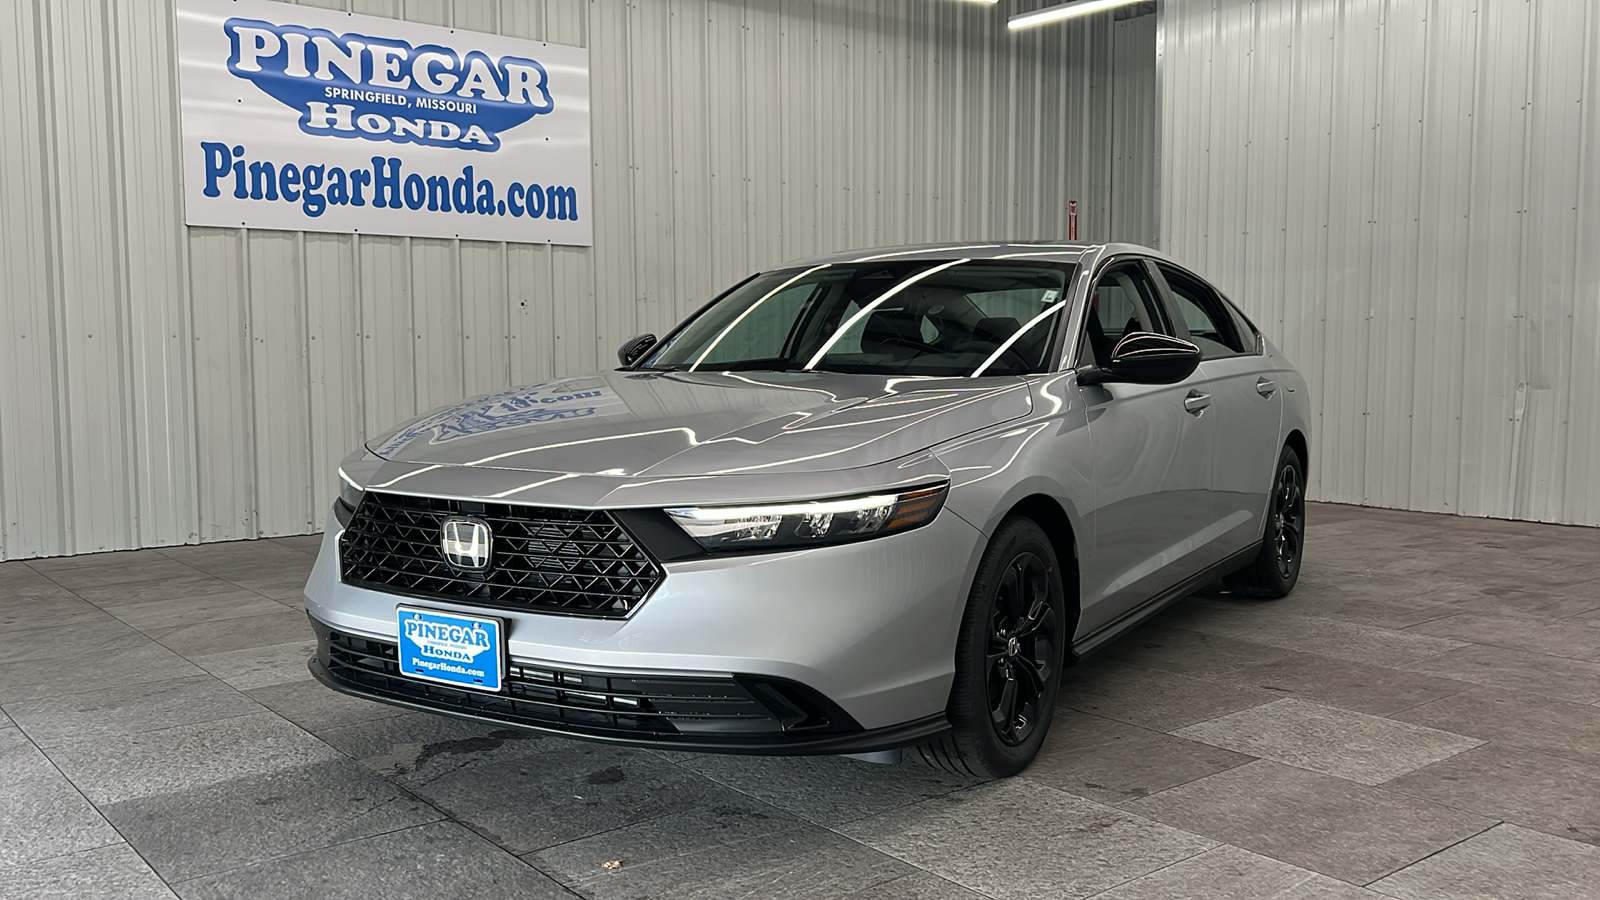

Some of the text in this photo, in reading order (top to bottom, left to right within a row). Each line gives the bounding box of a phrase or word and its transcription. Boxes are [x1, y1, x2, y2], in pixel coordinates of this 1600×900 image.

[233, 27, 549, 108] PINEGAR
[415, 97, 477, 114] MISSOURI
[306, 102, 495, 145] HONDA
[201, 141, 579, 221] PinegarHonda.com
[406, 621, 488, 648] PINEGAR
[423, 645, 471, 661] HONDA
[412, 657, 485, 677] PinegarHonda.com
